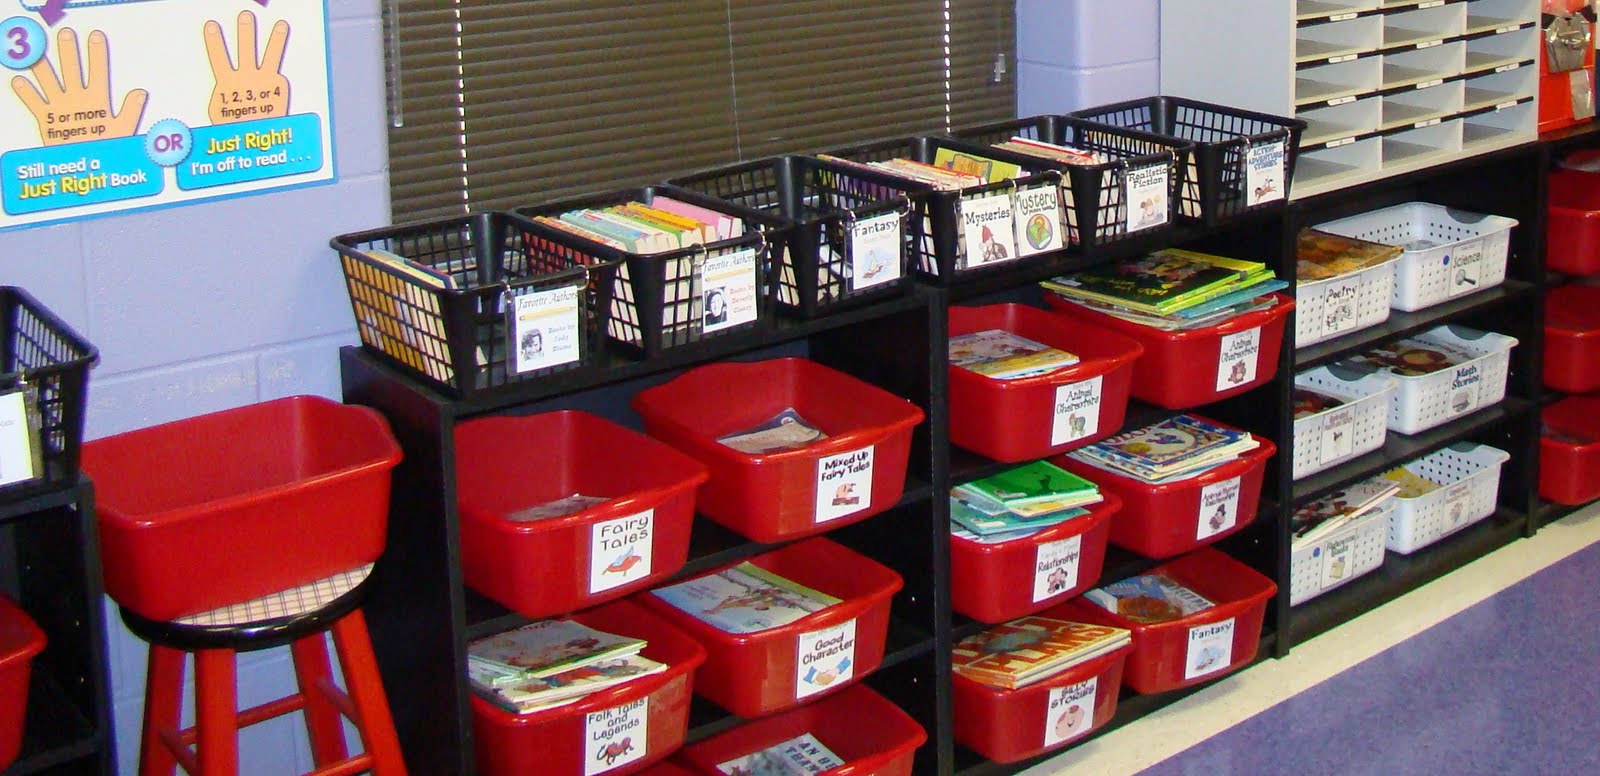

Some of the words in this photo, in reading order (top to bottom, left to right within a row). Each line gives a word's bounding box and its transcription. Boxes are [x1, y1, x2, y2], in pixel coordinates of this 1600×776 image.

[7, 27, 31, 59] 3
[260, 89, 271, 98] or
[274, 87, 280, 97] 4
[47, 113, 55, 124] 5
[59, 113, 72, 123] or
[74, 108, 107, 122] more
[221, 106, 257, 119] fingers
[260, 104, 273, 116] up
[47, 125, 88, 140] fingers
[91, 125, 106, 137] up
[206, 136, 241, 155] Just
[244, 128, 293, 150] Right!
[153, 133, 183, 152] OR
[17, 162, 45, 179] Still
[49, 160, 86, 174] need
[90, 158, 101, 171] a
[191, 162, 213, 176] I'm
[217, 158, 235, 172] off
[237, 158, 252, 170] to
[255, 150, 287, 166] read
[1129, 167, 1167, 181] Realistic
[1133, 177, 1163, 188] Fiction
[20, 182, 57, 200] Just
[61, 174, 107, 195] Right
[111, 170, 147, 187] Book
[965, 207, 1010, 226] Mysteries
[855, 220, 898, 237] Fantasy
[1453, 252, 1480, 268] Science
[518, 297, 548, 311] Favorite
[549, 291, 578, 304] Authors
[1457, 365, 1477, 380] Math
[1452, 375, 1479, 390] Stories
[1066, 385, 1092, 402] Animal
[825, 453, 855, 470] Mixed
[822, 469, 845, 482] Fairy
[848, 461, 870, 473] Tales
[601, 517, 648, 537] Fairy
[601, 530, 648, 551] Tales
[1192, 623, 1232, 640] Fantasy
[815, 632, 844, 651] Good
[803, 639, 853, 665] Character
[1051, 684, 1094, 709] STORIES
[589, 710, 612, 724] Folk
[618, 699, 644, 714] Tales
[608, 713, 627, 727] and
[593, 719, 639, 740] Legends
